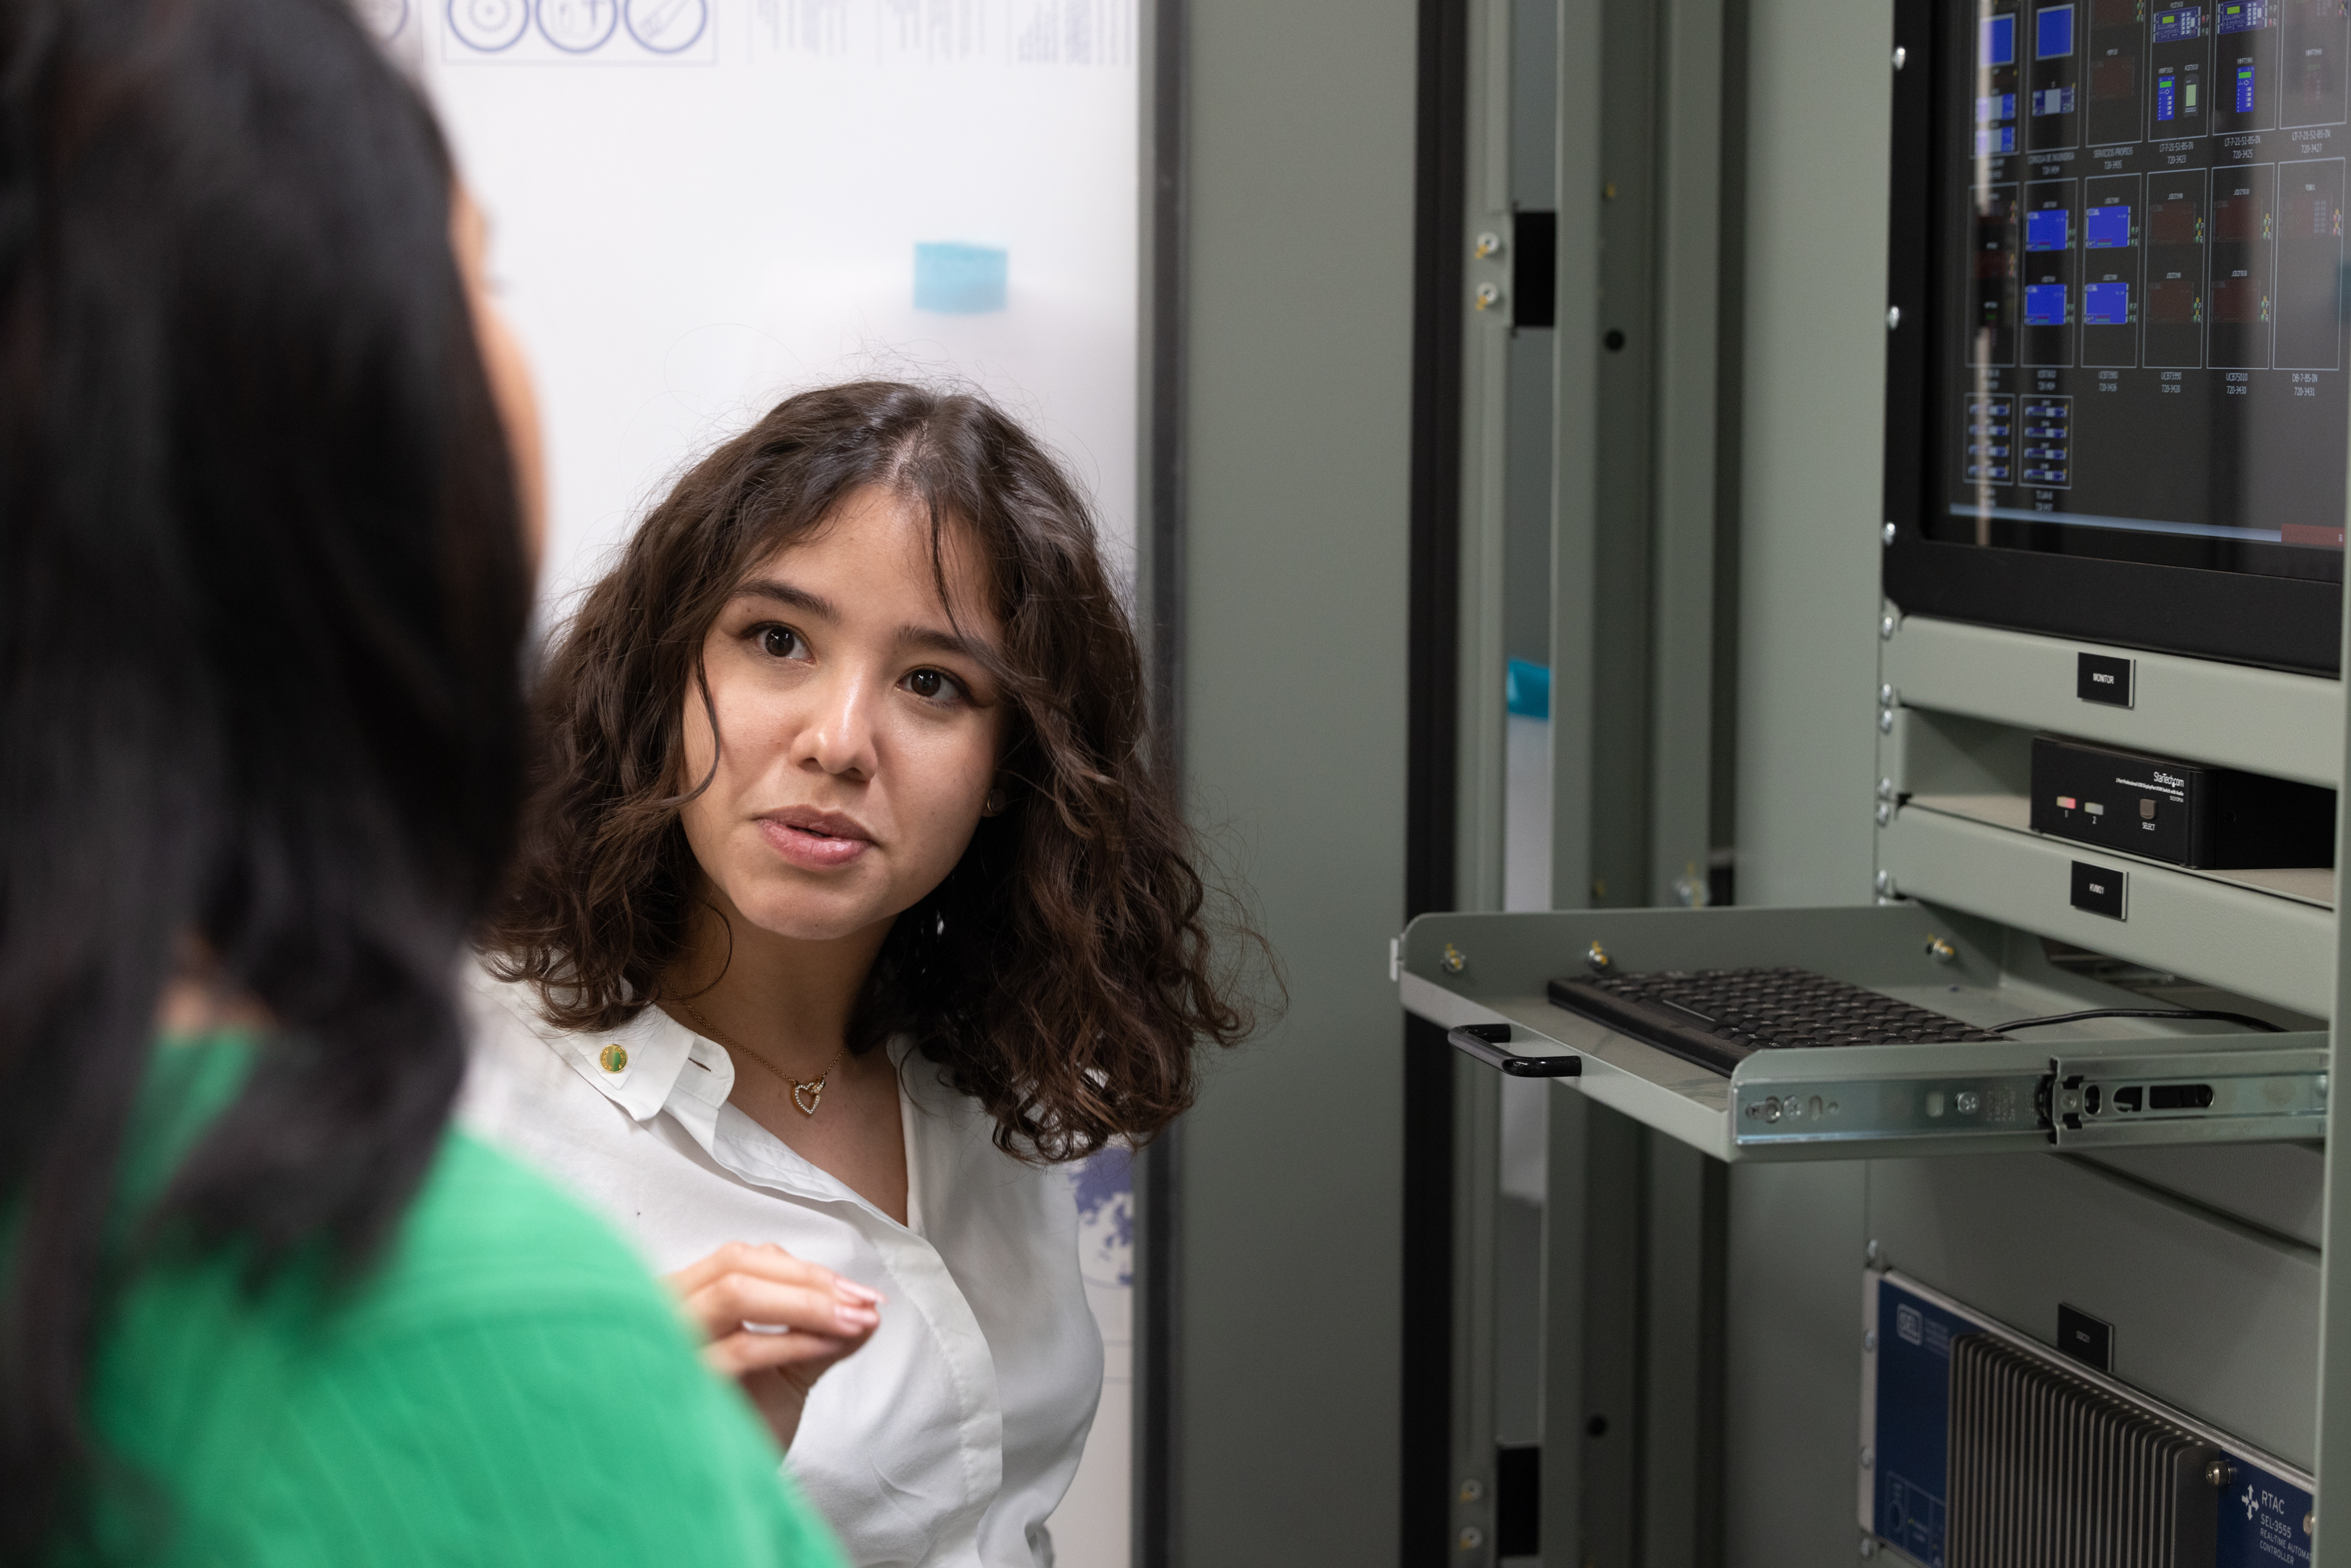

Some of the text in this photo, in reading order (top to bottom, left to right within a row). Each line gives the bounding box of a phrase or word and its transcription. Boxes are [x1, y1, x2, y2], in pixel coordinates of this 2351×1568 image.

[2233, 149, 2253, 159] 720-3425
[2301, 143, 2323, 154] 720-3427
[2226, 372, 2248, 382] UCB75010
[2291, 373, 2318, 383] DB-7-BS-IN
[2226, 386, 2247, 394] 720-3430
[2294, 386, 2315, 397] 720-3431
[2092, 672, 2114, 684] MONITOR
[2154, 771, 2184, 788] StarTech.com
[2064, 809, 2069, 818] 1
[2092, 816, 2097, 825] 2
[2142, 821, 2156, 831] SELECT
[2262, 1490, 2284, 1515] RTAC
[2260, 1513, 2291, 1538] SEL-3555
[2260, 1527, 2287, 1549] REAL-TIME
[2259, 1540, 2295, 1566] CONTROLLER
